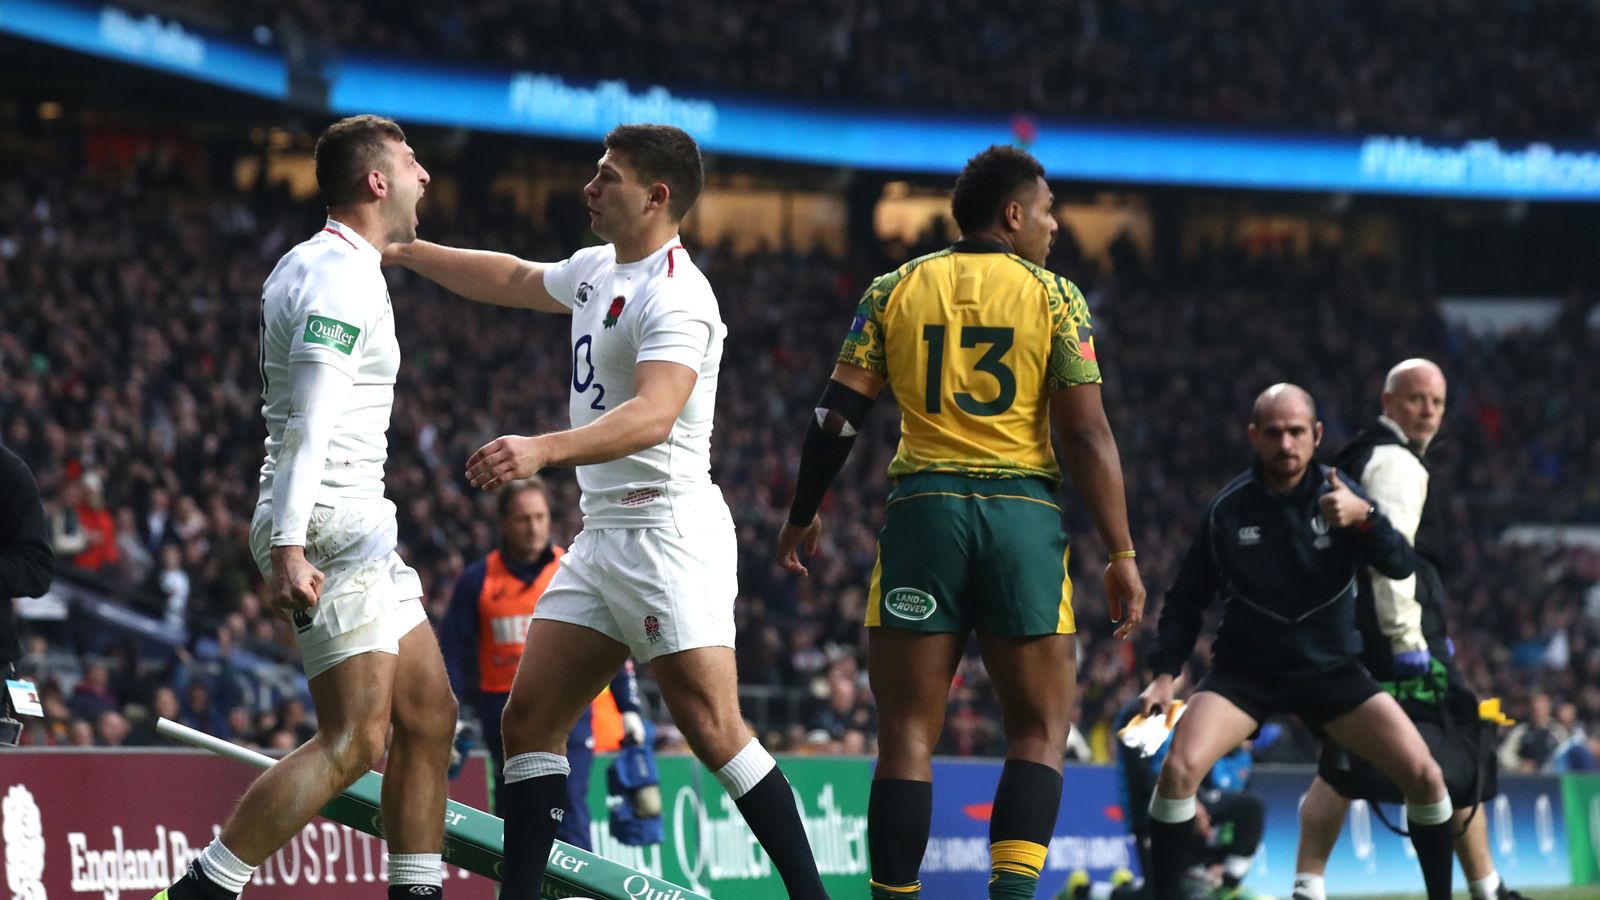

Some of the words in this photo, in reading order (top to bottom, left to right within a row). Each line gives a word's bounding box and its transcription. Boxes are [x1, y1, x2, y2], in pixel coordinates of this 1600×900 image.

[310, 320, 354, 345] Quilter
[923, 324, 1017, 416] 13
[67, 825, 171, 900] England
